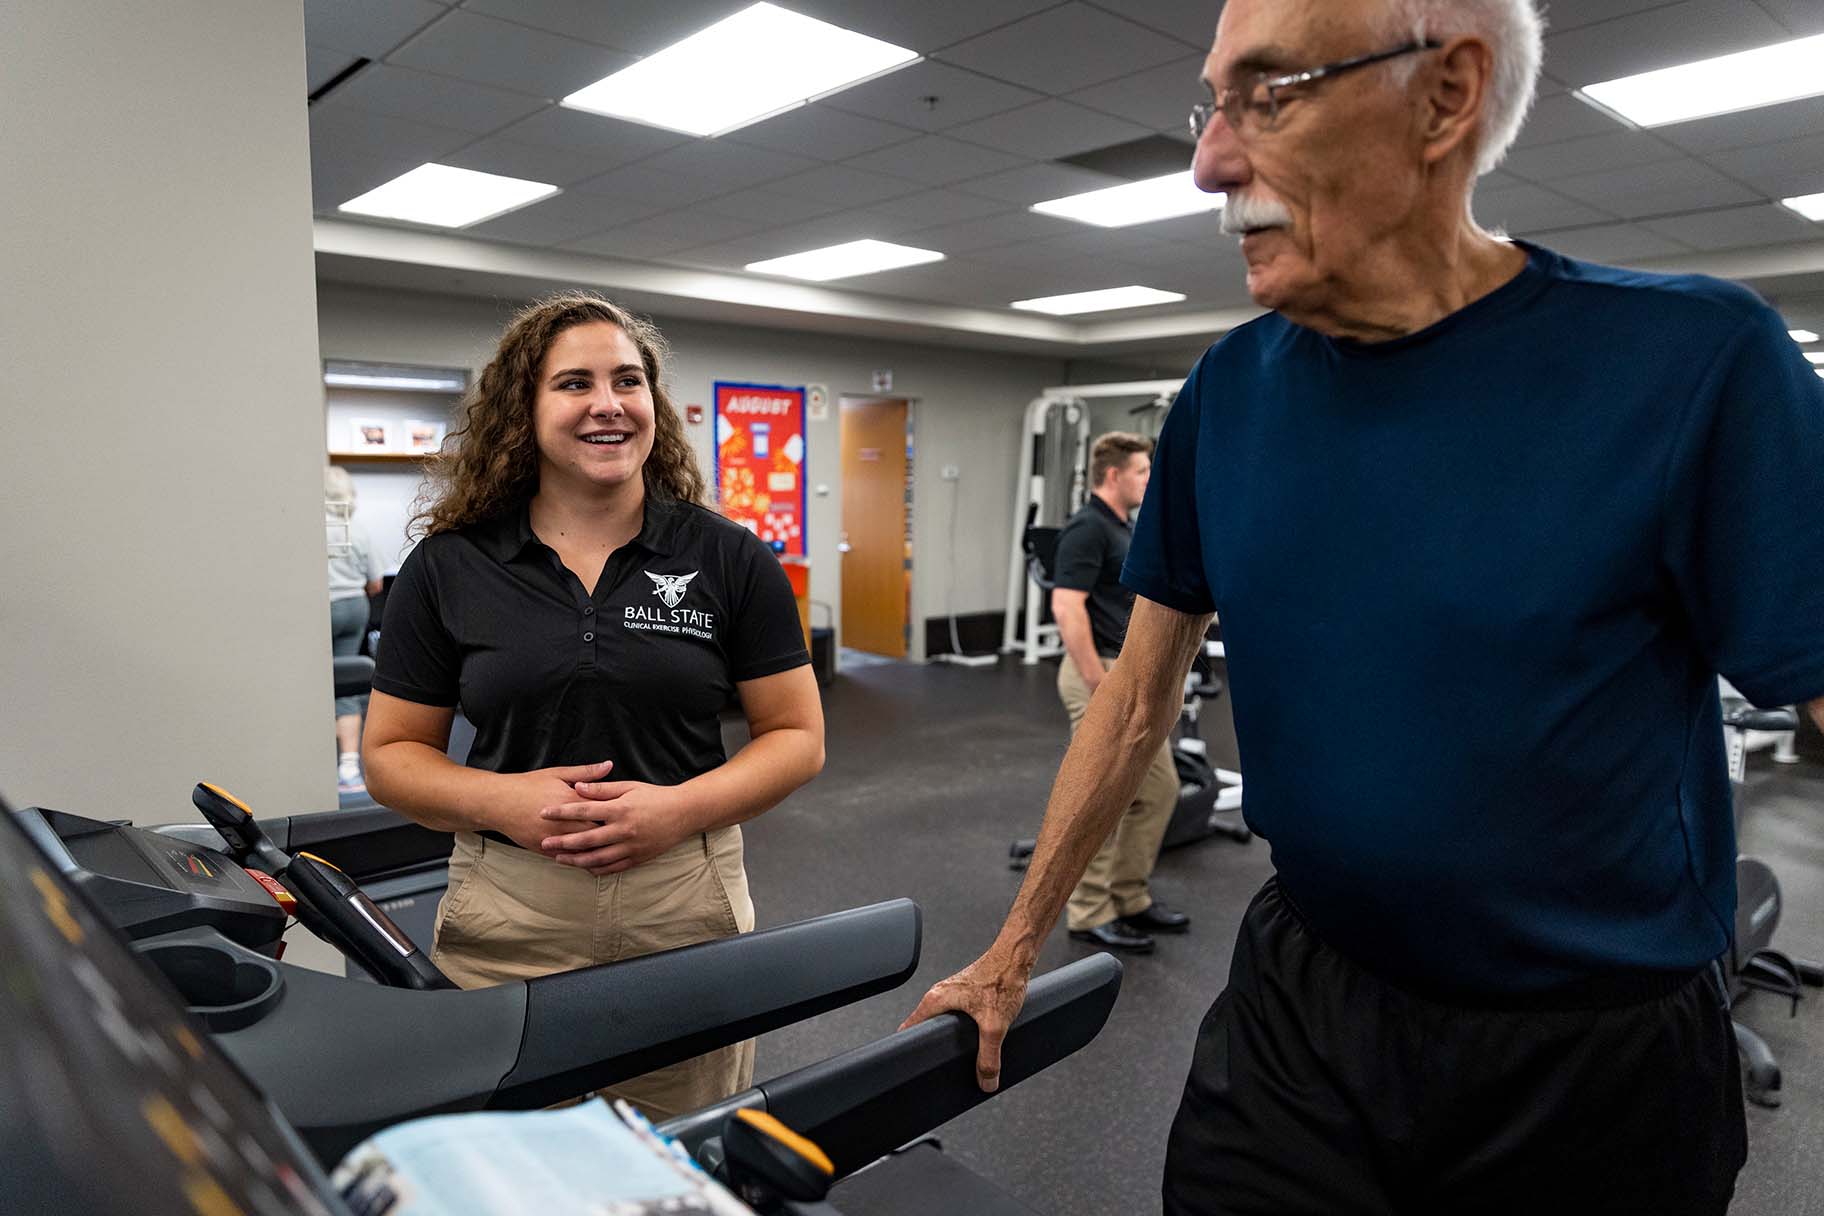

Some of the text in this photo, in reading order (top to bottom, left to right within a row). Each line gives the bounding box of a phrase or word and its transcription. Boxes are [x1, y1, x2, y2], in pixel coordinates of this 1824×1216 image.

[726, 396, 792, 415] AUGUST
[624, 606, 713, 628] BALL STATE
[624, 621, 712, 639] CLINICAL EXERCISE PHYSIOLOGY
